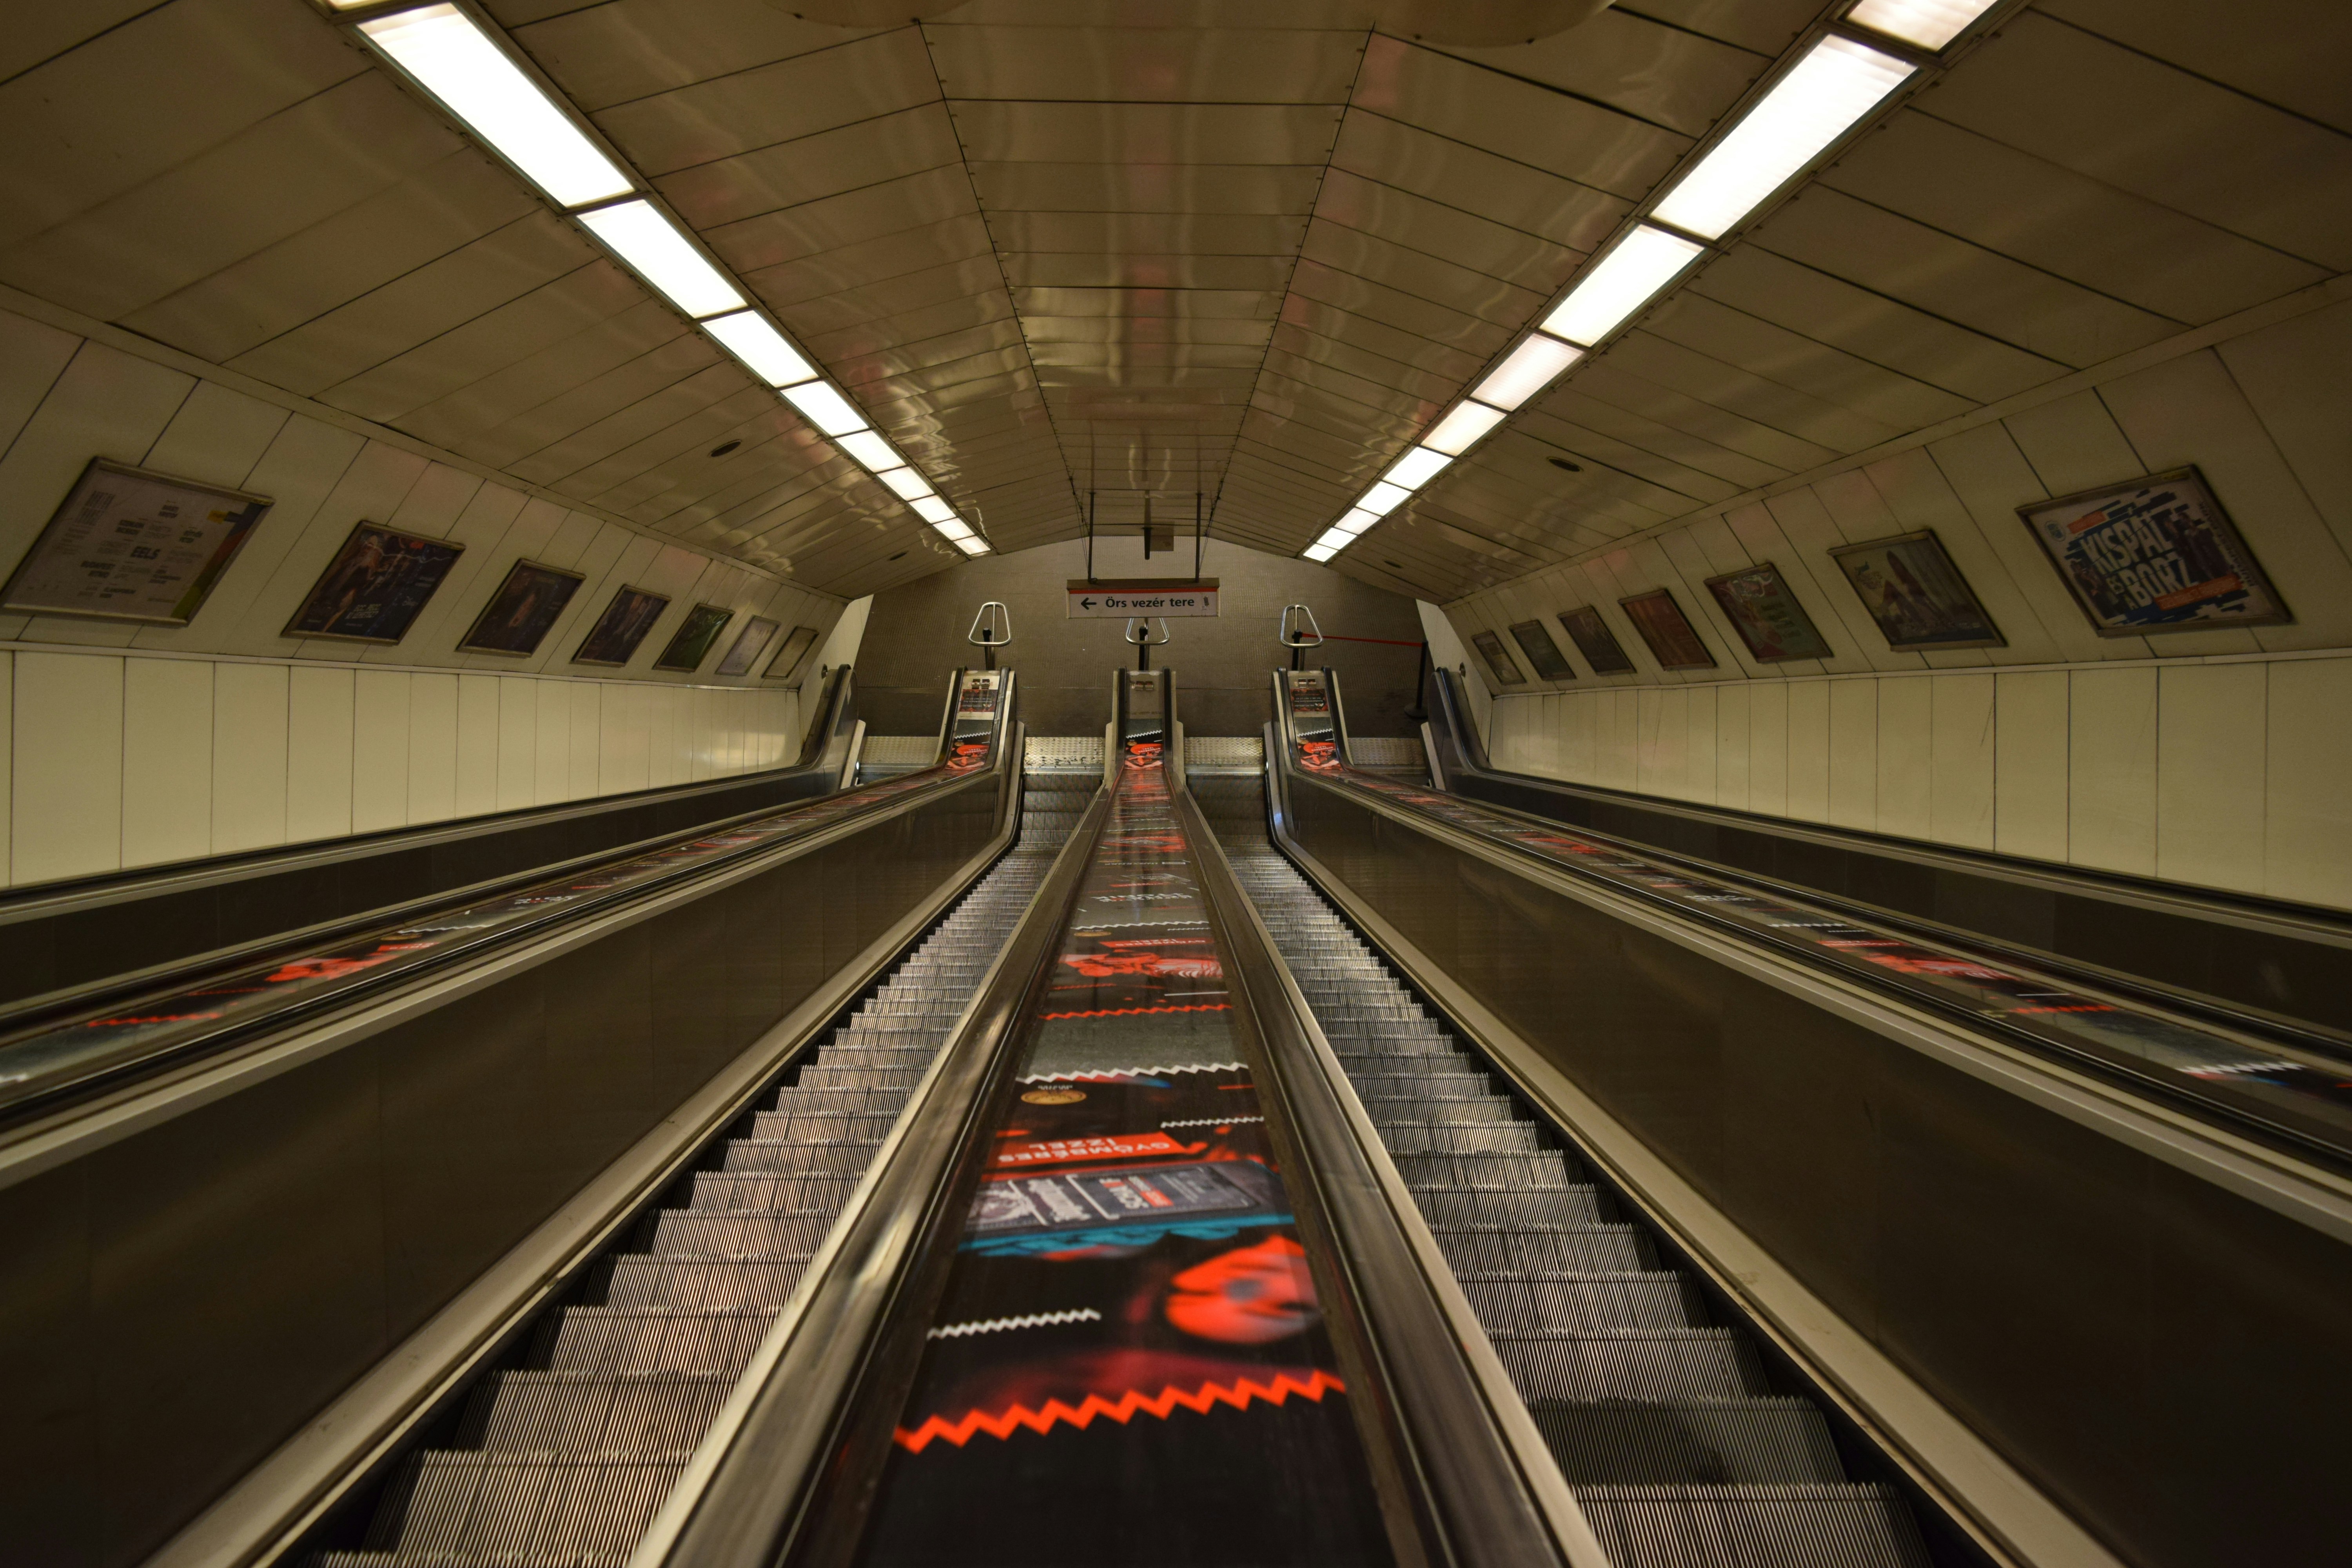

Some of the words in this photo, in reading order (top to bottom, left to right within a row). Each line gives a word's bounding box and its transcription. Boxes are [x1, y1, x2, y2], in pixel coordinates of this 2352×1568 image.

[2079, 506, 2174, 576] KISPÁL
[130, 546, 161, 560] EELS
[2120, 553, 2198, 606] BORZ
[1105, 596, 1127, 608] Örs
[1132, 597, 1165, 608] vezér
[1170, 597, 1194, 607] tere
[997, 1141, 1170, 1164] GYÖMBÉRES
[1029, 1137, 1117, 1151] ÍZZEL
